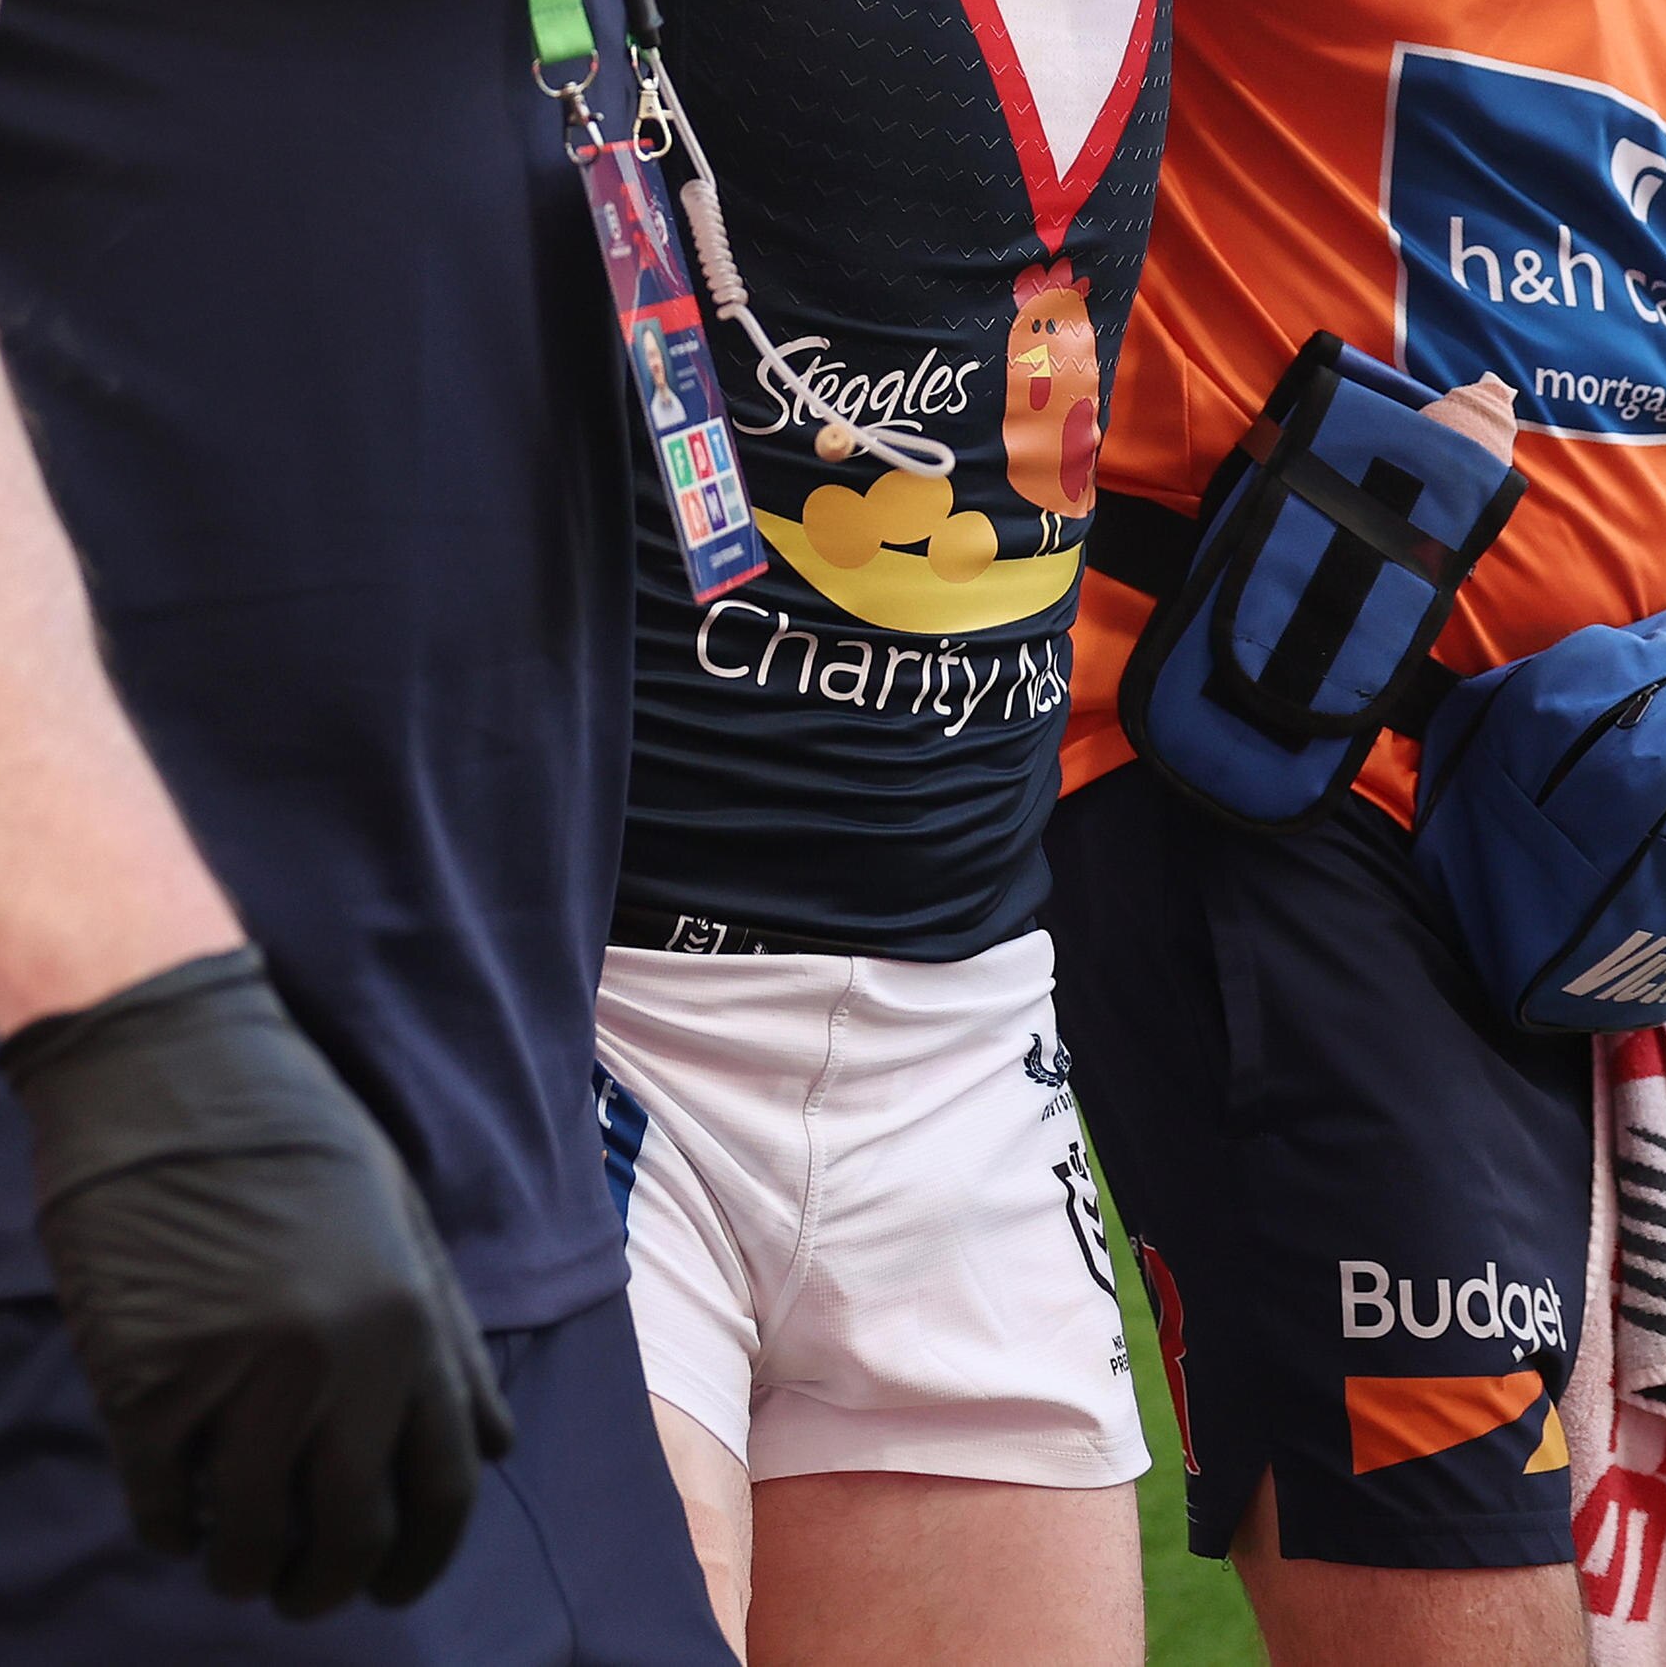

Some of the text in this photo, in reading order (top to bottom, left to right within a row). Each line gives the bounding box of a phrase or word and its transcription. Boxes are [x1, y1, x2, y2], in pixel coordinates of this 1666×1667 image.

[1449, 215, 1606, 313] h&h
[733, 335, 981, 457] Steggles
[696, 598, 1000, 738] Charity
[1338, 1260, 1567, 1363] Budget
